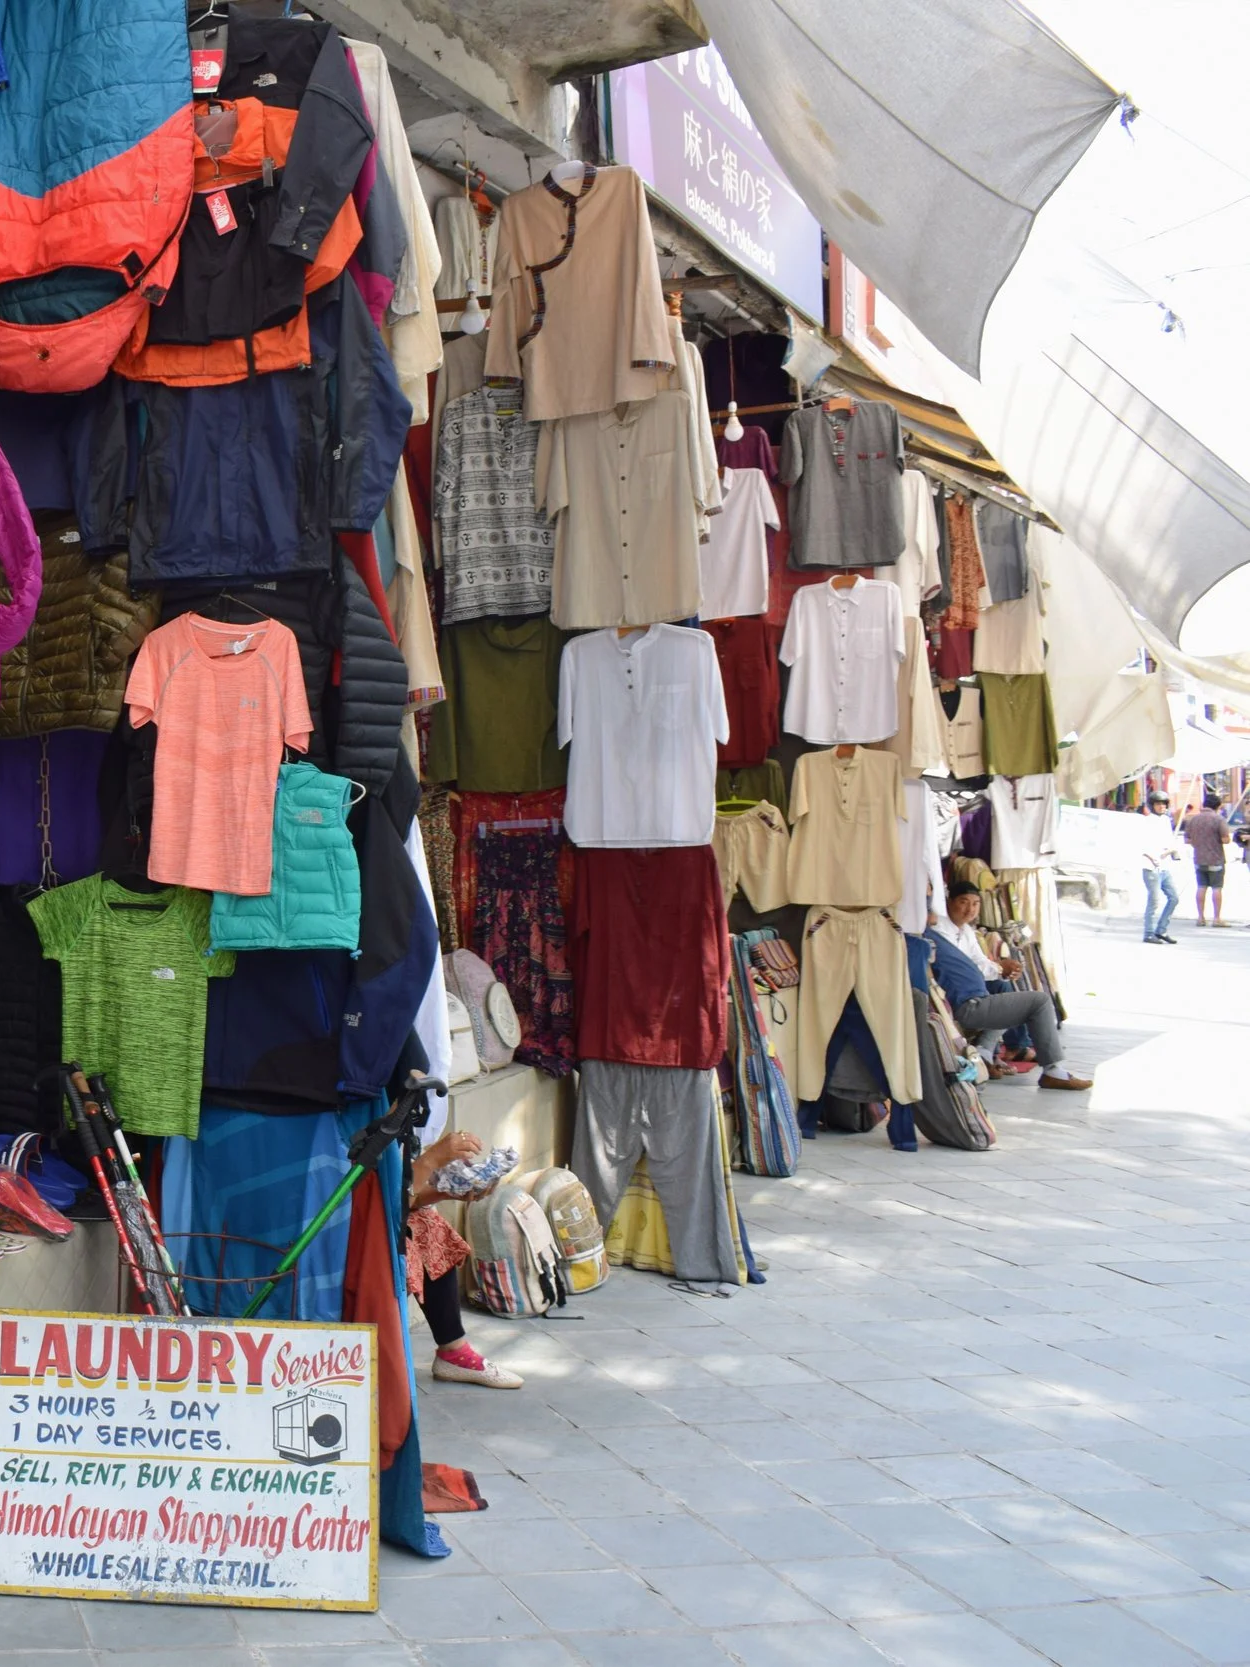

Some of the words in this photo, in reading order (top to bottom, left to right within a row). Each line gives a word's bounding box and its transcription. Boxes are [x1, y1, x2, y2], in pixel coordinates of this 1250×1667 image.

[271, 1339, 365, 1389] Service
[8, 1394, 30, 1414] 3
[37, 1395, 116, 1420] HOURS
[170, 1400, 221, 1422] DAY
[12, 1422, 22, 1443] 1
[36, 1422, 84, 1445] DAY
[96, 1425, 232, 1451] SERVICES.
[0, 1457, 57, 1487] SELL,
[65, 1461, 127, 1491] RENT,
[137, 1462, 183, 1489] BUY
[186, 1466, 202, 1491] &
[153, 1495, 289, 1560] Shopping
[291, 1502, 371, 1553] Center
